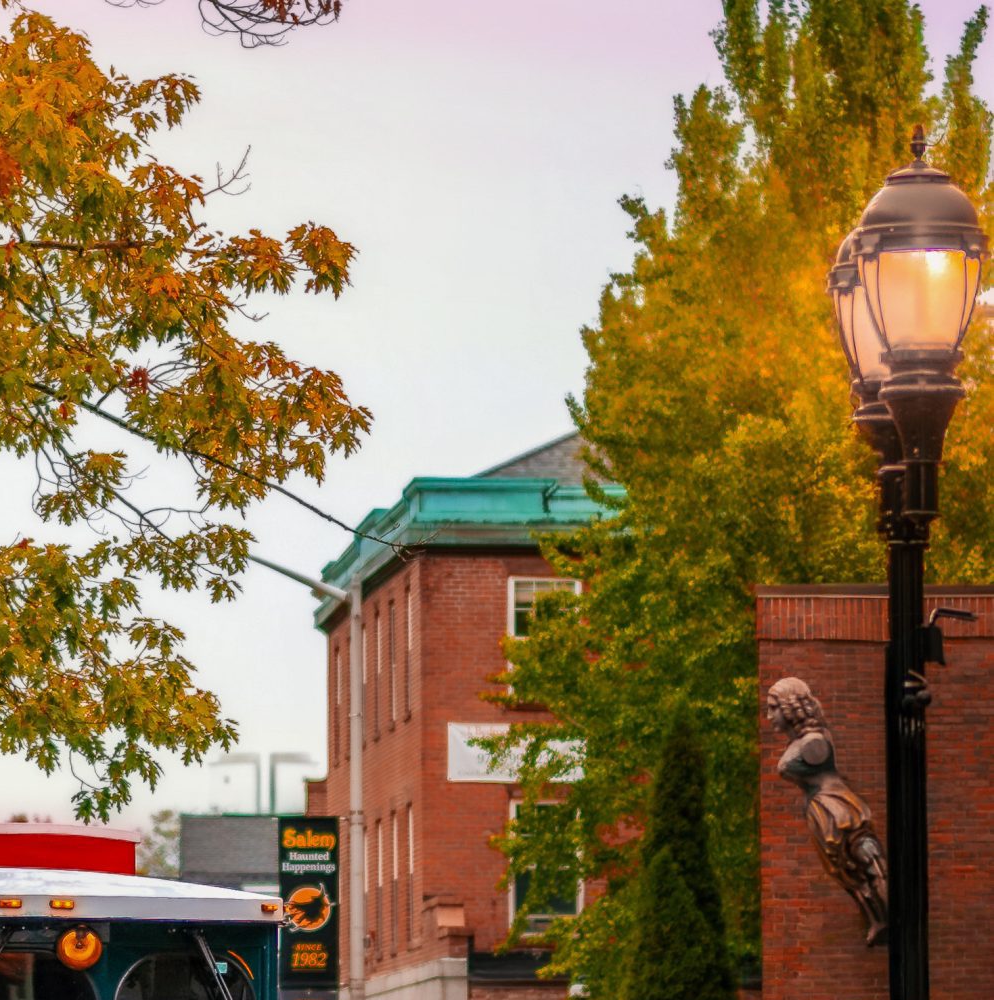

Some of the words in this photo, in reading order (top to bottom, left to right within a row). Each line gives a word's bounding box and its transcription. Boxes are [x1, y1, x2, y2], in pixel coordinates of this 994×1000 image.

[283, 828, 335, 851] Salem
[289, 852, 330, 860] Haunted
[282, 863, 335, 873] Happenings
[296, 943, 322, 951] SINCE
[292, 952, 327, 967] 1982
